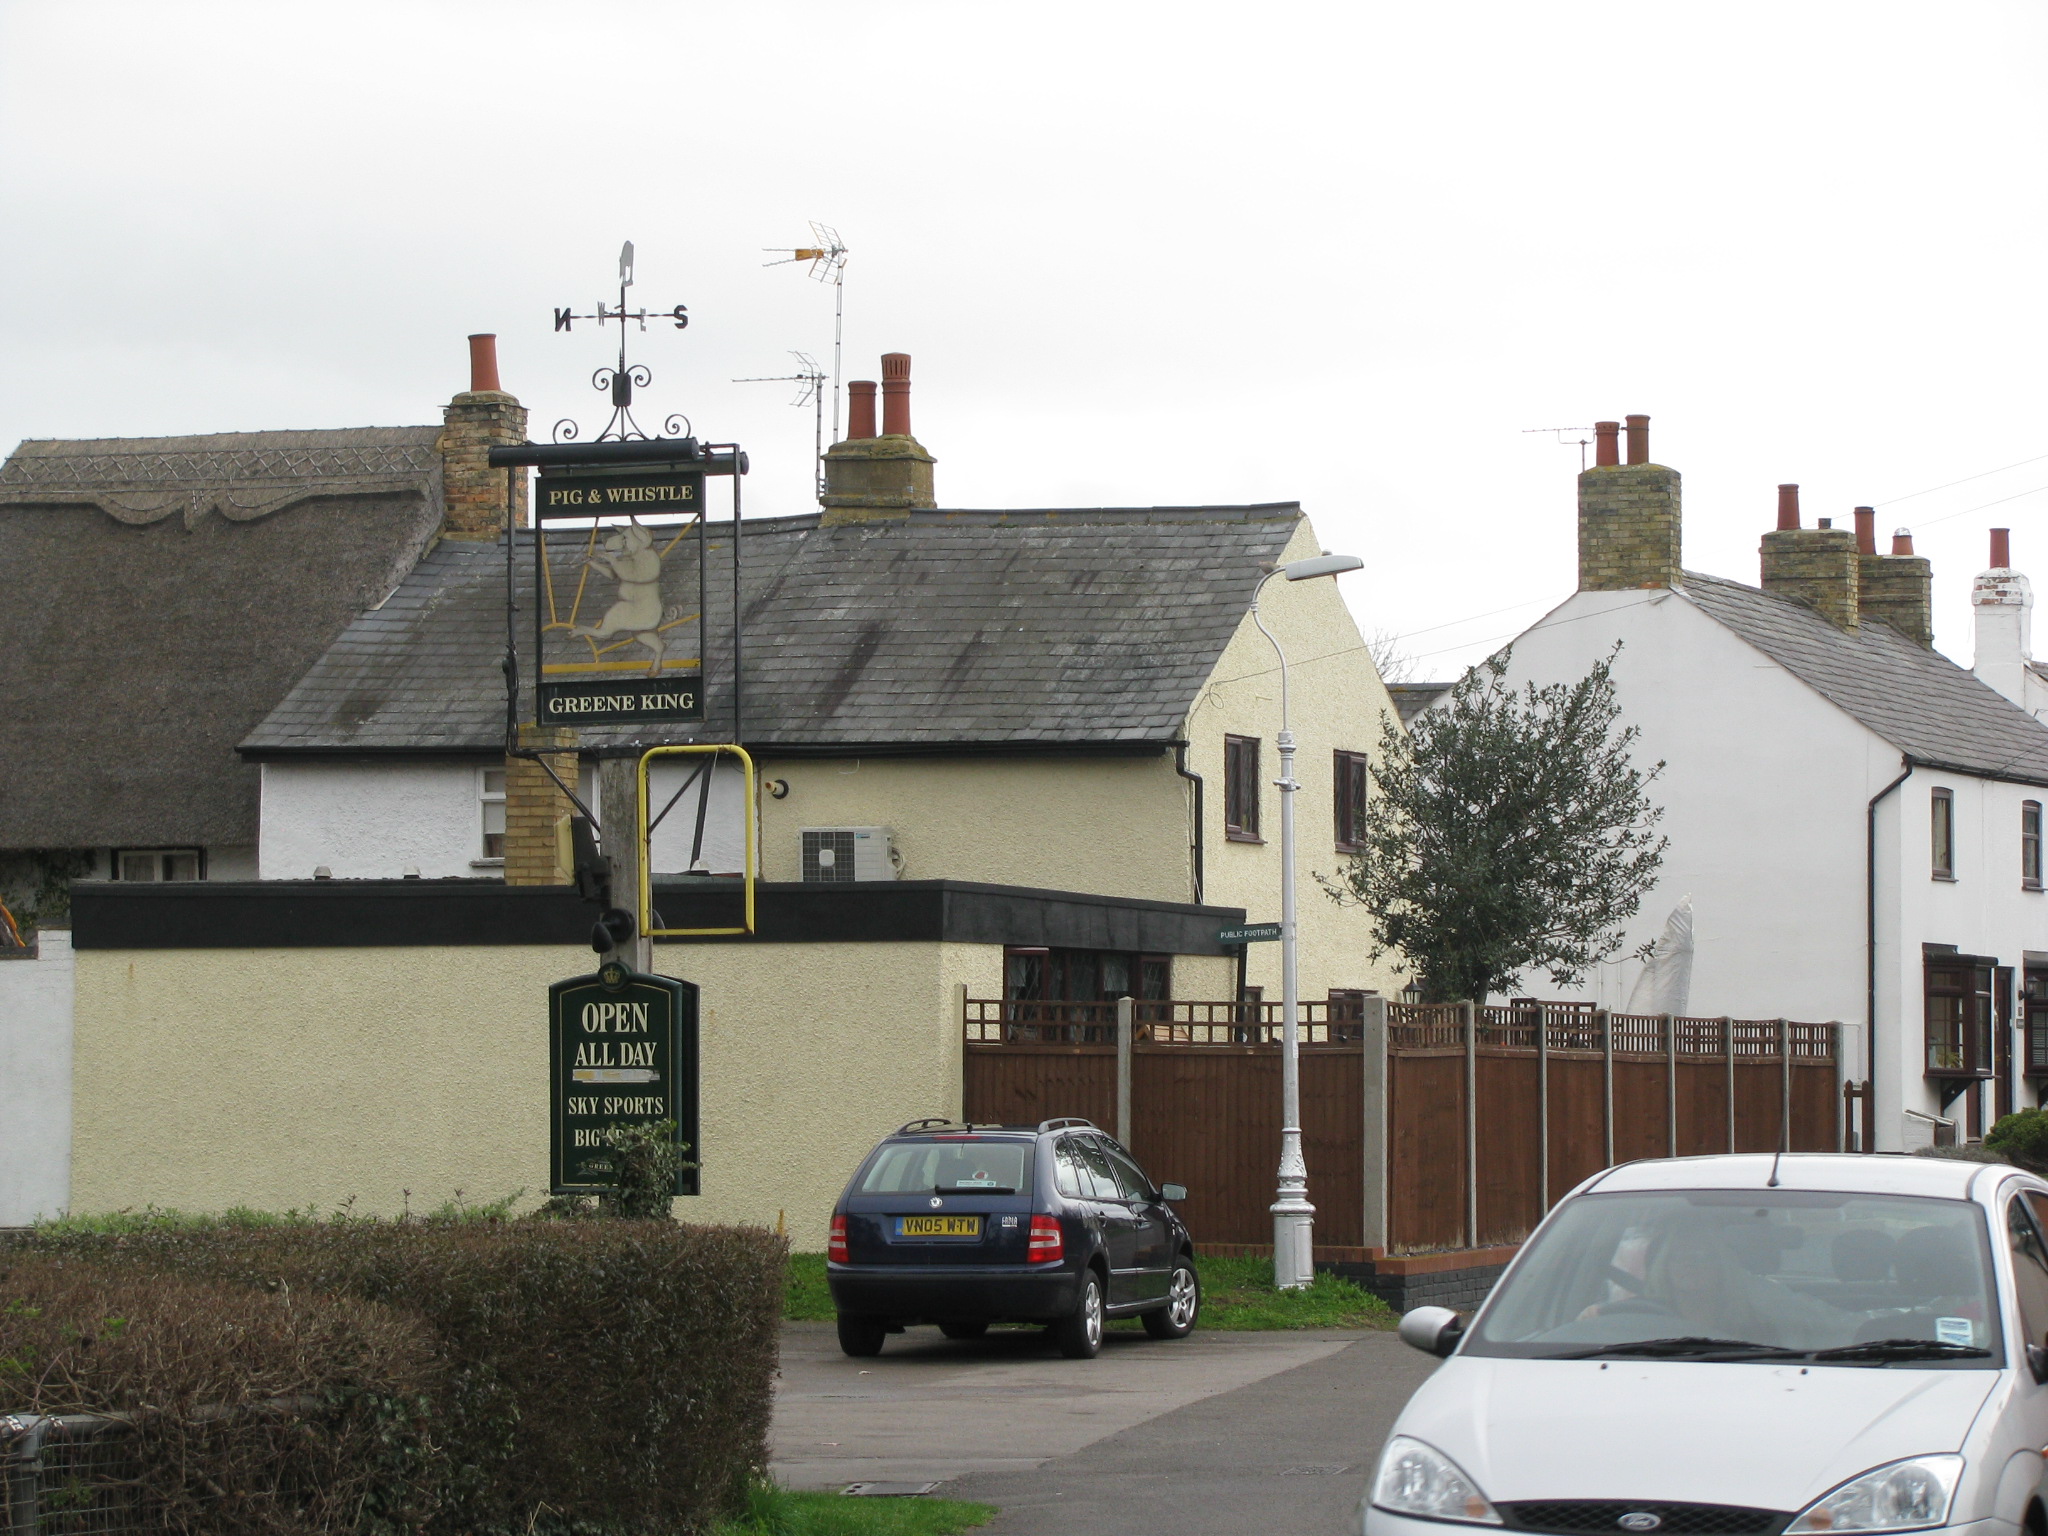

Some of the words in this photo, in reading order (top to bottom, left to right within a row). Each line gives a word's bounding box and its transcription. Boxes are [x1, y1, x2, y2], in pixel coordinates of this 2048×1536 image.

[673, 304, 688, 329] S
[549, 489, 584, 506] PIG
[588, 488, 602, 504] &
[606, 485, 693, 503] WHISTLE
[549, 695, 635, 714] GREENE
[640, 692, 694, 711] KING
[1220, 930, 1243, 939] PUBLIC
[1244, 928, 1277, 937] FOOTPATH
[581, 1002, 649, 1034] OPEN
[574, 1042, 615, 1067] ALL
[620, 1042, 658, 1067] DAY
[568, 1096, 599, 1115] SKY
[604, 1096, 664, 1115] SPORTS
[574, 1129, 600, 1147] BIG
[906, 1218, 943, 1233] VN05
[947, 1218, 976, 1233] WTW
